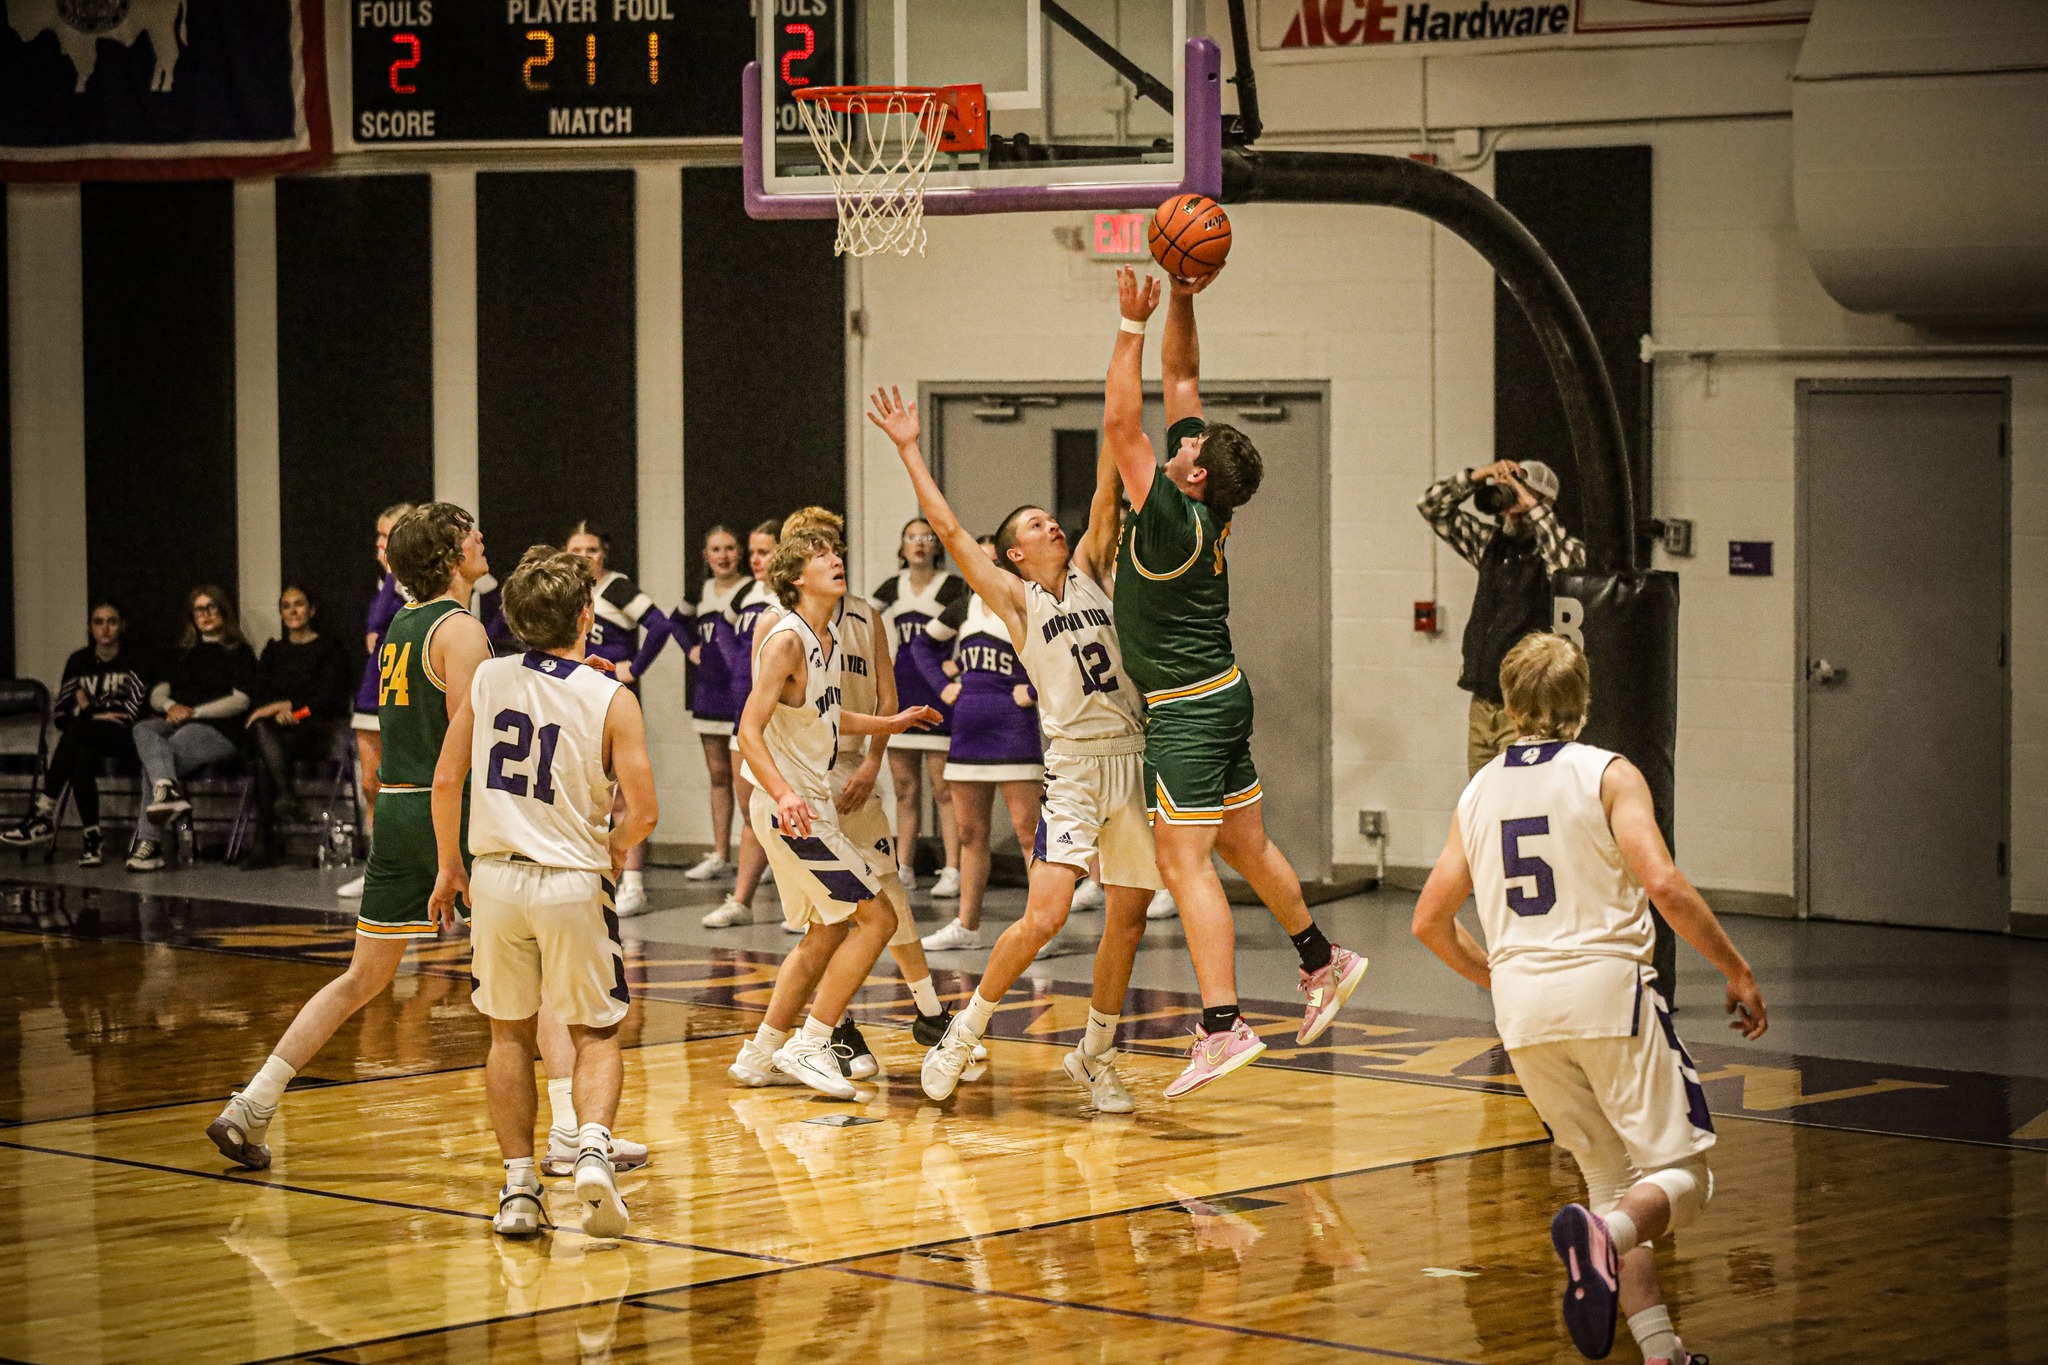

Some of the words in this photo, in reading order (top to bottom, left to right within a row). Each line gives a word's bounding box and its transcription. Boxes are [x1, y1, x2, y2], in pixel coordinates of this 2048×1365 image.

[359, 1, 433, 27] FOULS
[507, 0, 597, 24] PLAYER
[613, 0, 675, 22] FOUL
[751, 0, 827, 17] ULS
[1281, 0, 1398, 47] ACE
[1403, 1, 1569, 42] Hardware
[389, 33, 421, 93] 2
[781, 24, 814, 86] 2
[360, 110, 435, 138] SCORE
[549, 106, 633, 135] MATCH
[1094, 214, 1145, 253] EXIT
[379, 641, 410, 706] 24
[1071, 641, 1119, 696] 12
[486, 708, 561, 805] 21
[1501, 815, 1556, 917] 5
